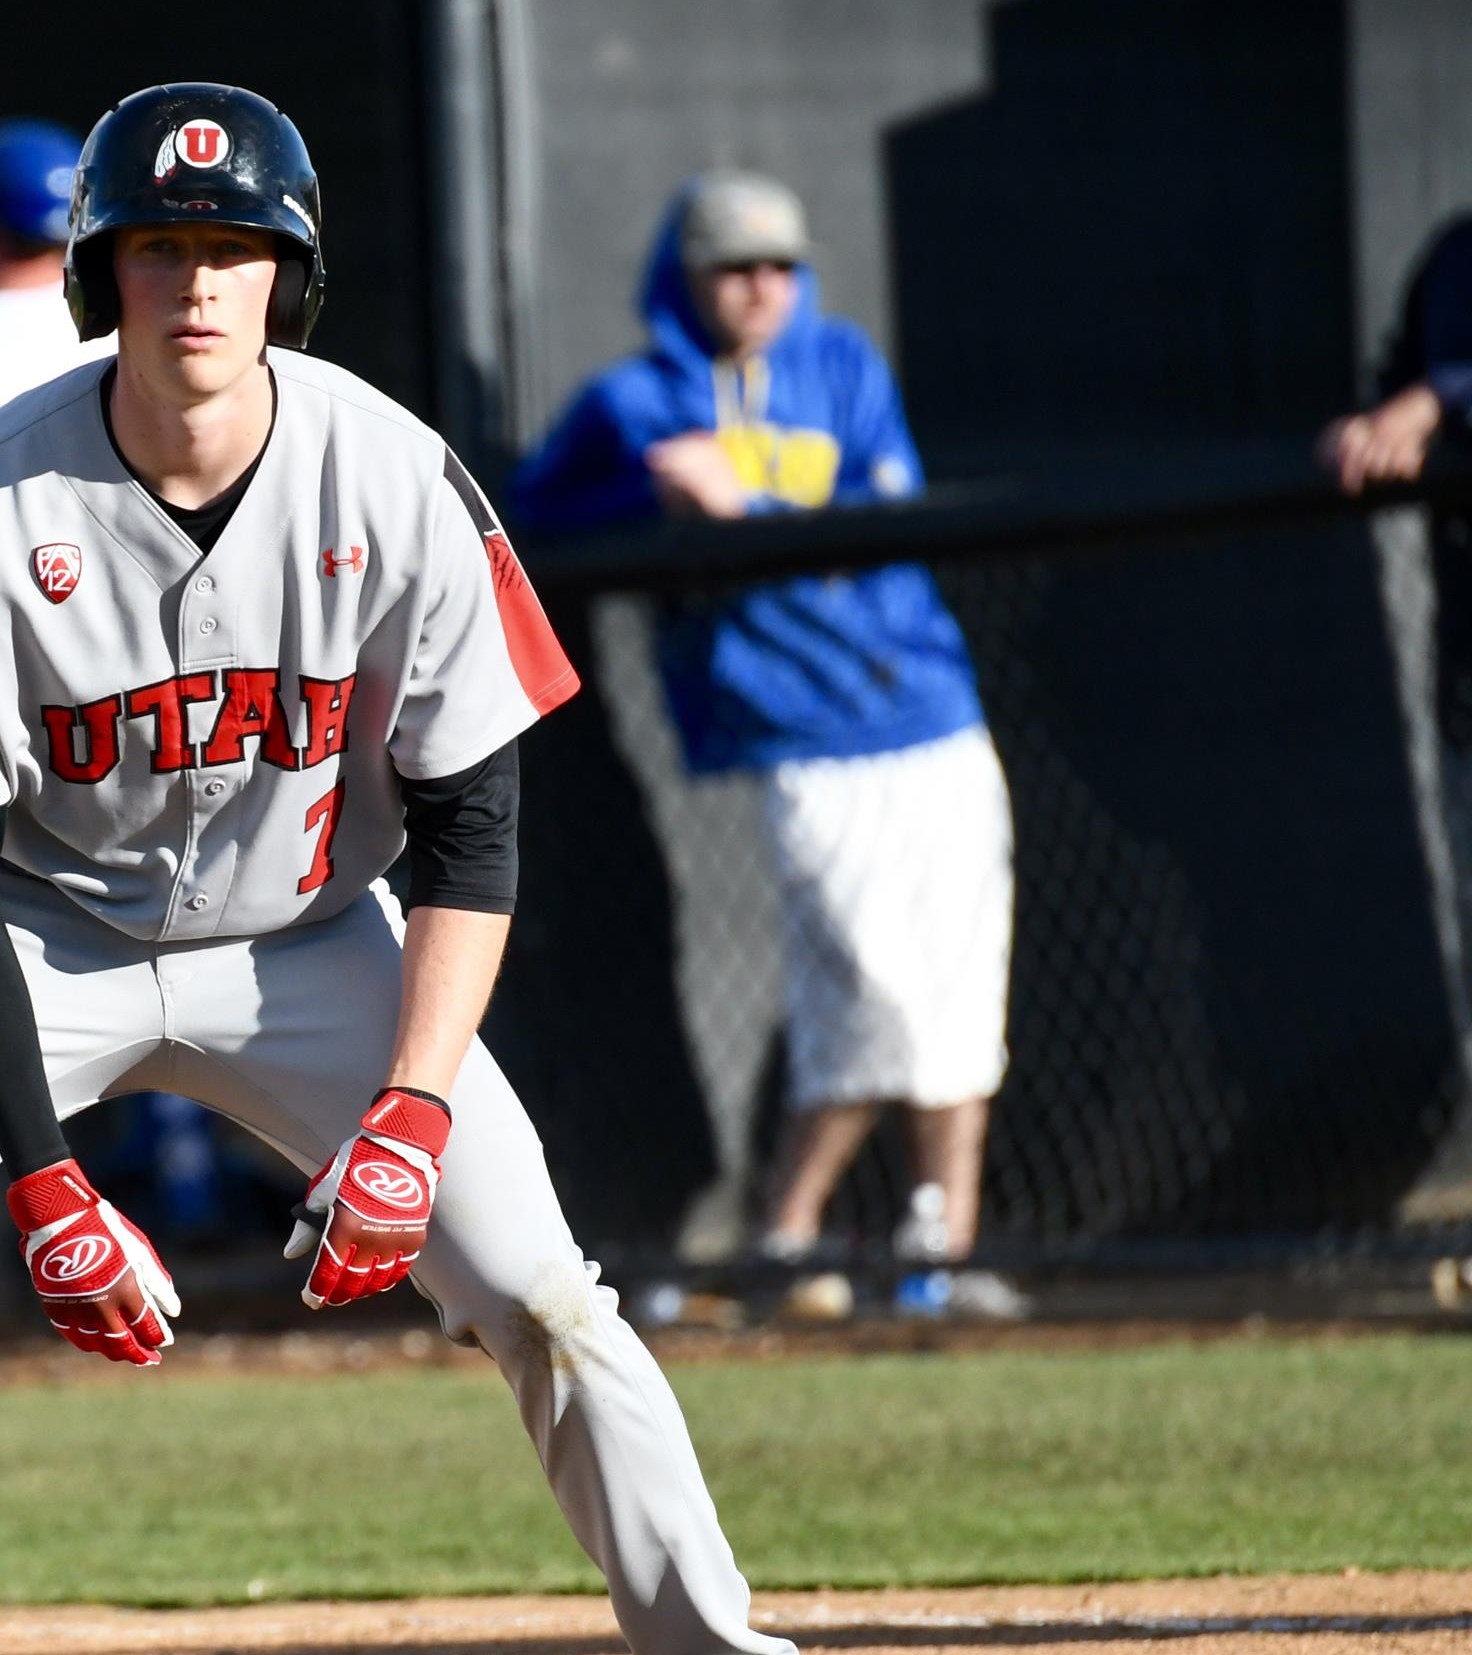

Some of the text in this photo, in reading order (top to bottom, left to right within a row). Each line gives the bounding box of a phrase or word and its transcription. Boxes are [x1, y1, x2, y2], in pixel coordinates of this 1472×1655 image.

[184, 128, 220, 162] U
[37, 545, 80, 580] PAC
[48, 569, 73, 591] 12
[41, 667, 357, 784] UTAH
[297, 778, 345, 895] 7
